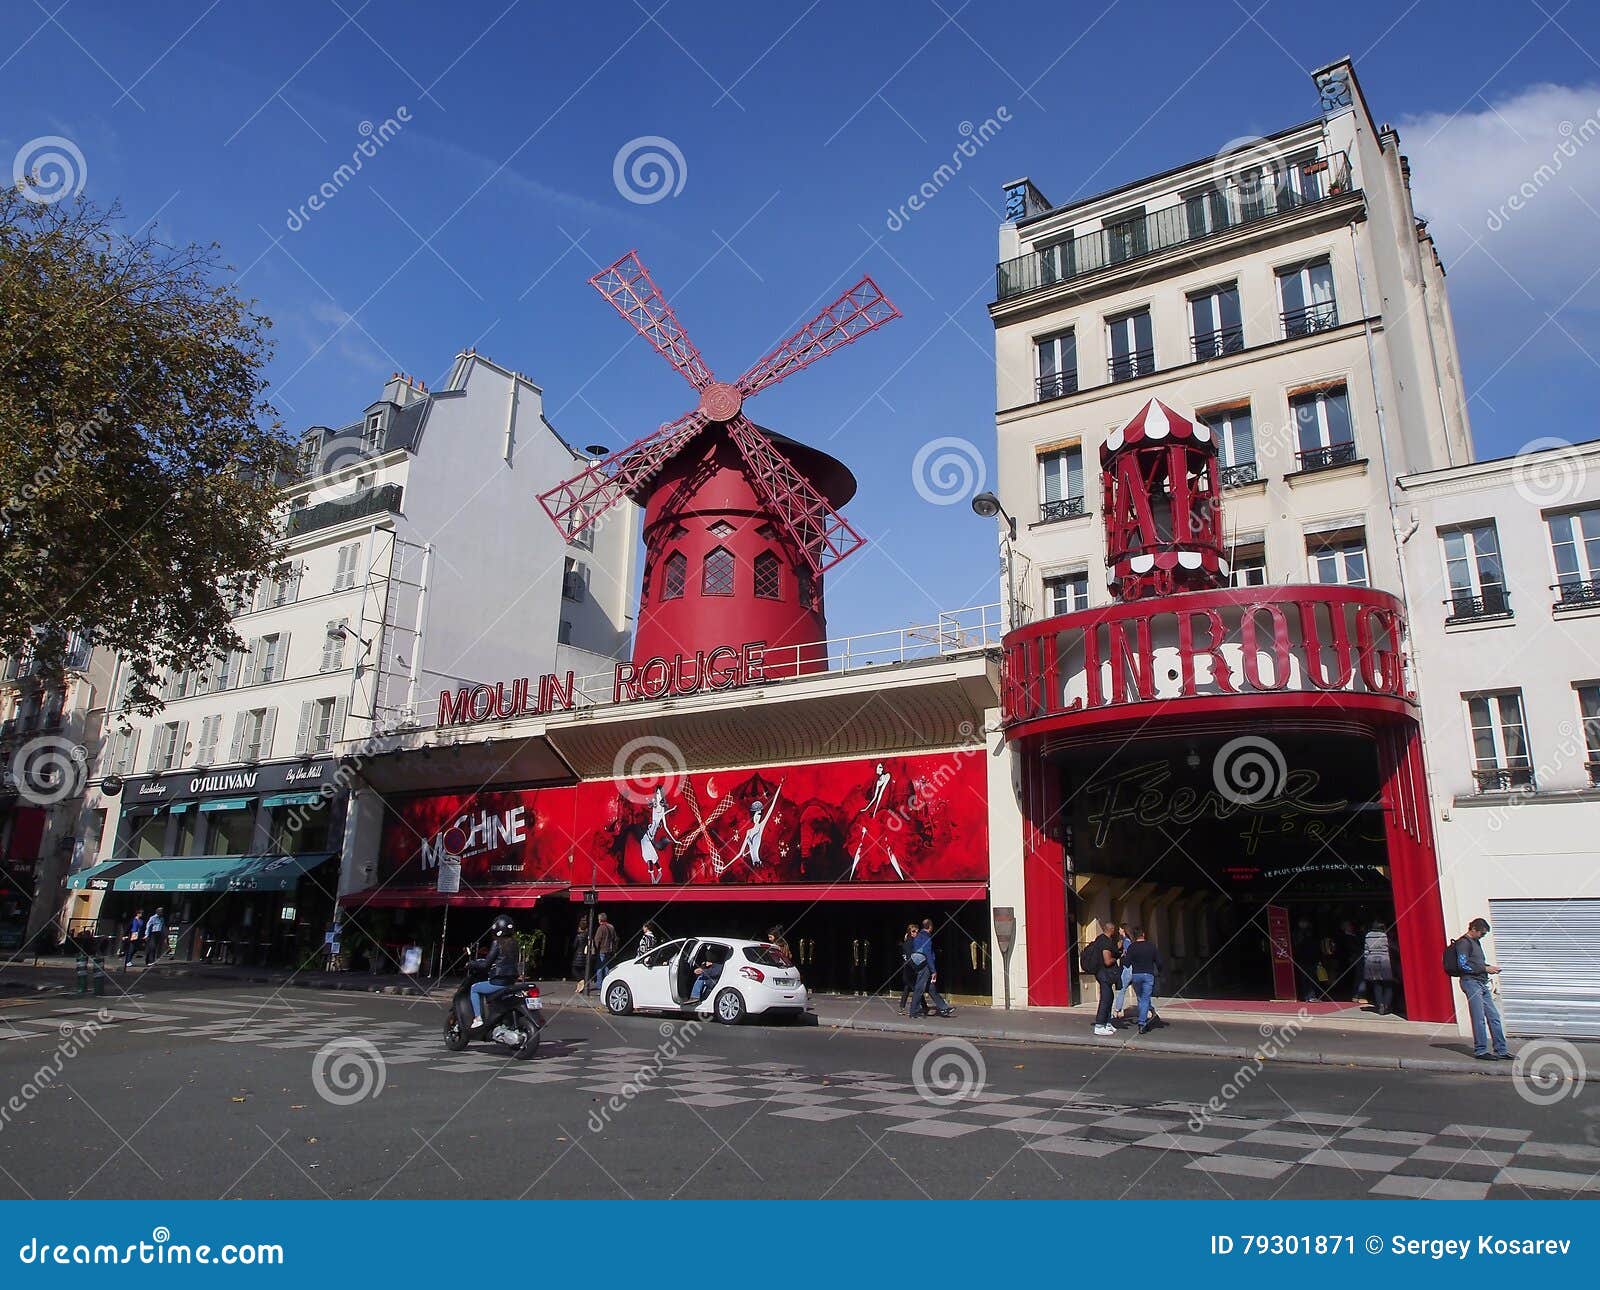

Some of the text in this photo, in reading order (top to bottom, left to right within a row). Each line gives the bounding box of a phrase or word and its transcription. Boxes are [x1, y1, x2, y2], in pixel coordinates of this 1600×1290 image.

[437, 640, 767, 727] MOULIN ROUGE
[190, 772, 258, 793] O'SULLIVANS
[285, 769, 296, 784] By
[306, 765, 323, 779] Mill
[421, 806, 526, 871] MCHINE
